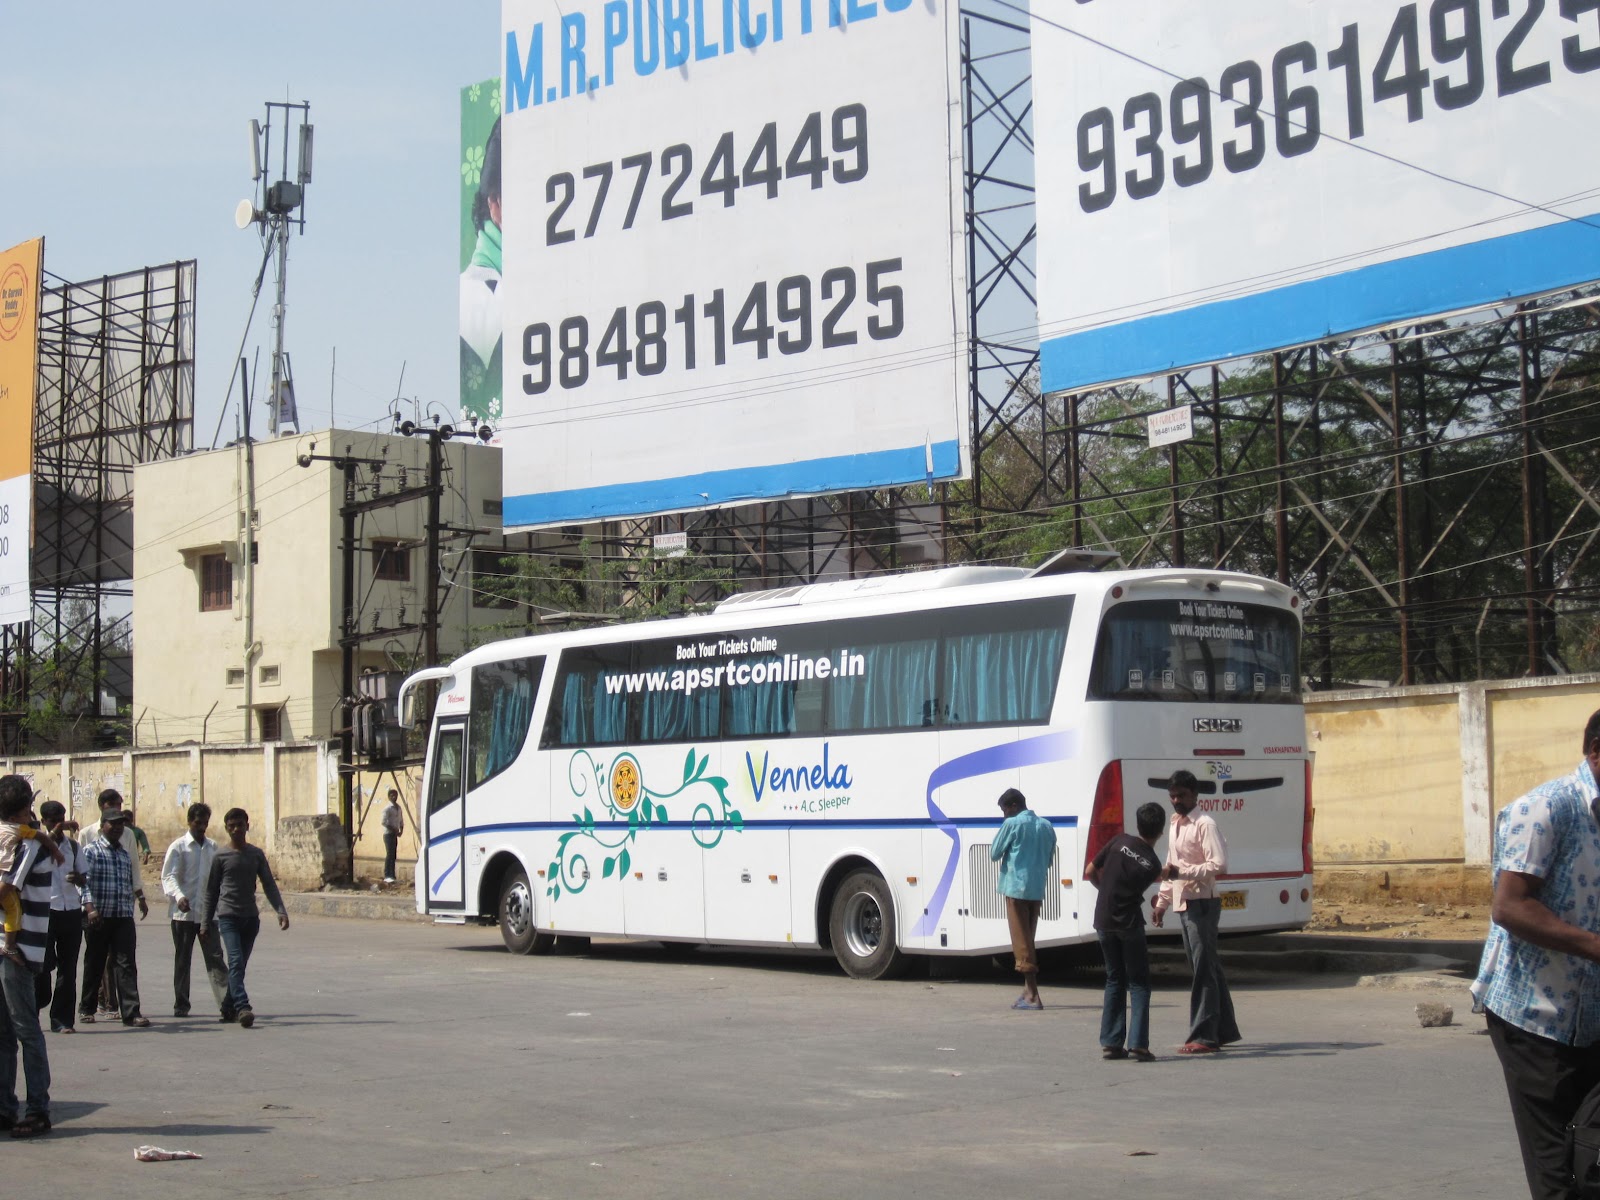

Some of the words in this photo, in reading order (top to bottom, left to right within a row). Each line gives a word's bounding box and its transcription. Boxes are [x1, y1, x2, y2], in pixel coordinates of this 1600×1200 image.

[505, 0, 913, 114] M.R.PUBLIC
[545, 102, 869, 247] 27724449
[522, 257, 904, 395] 9848114925
[1179, 601, 1194, 616] Book
[1194, 603, 1207, 617] Your
[1206, 603, 1227, 619] Tickets
[1227, 605, 1244, 620] Online
[1170, 623, 1254, 641] www.apsrtconline.in
[676, 645, 697, 660] Book
[698, 642, 717, 658] Your
[718, 639, 749, 656] Tickets
[750, 636, 778, 653] Online
[604, 649, 865, 695] www.apsrtconline.in
[1193, 718, 1242, 732] ISUZU
[745, 741, 853, 803] Vennela
[818, 795, 851, 811] Sleeper
[1198, 799, 1220, 812] GOVT
[1221, 799, 1232, 812] OF
[1234, 799, 1244, 811] AP
